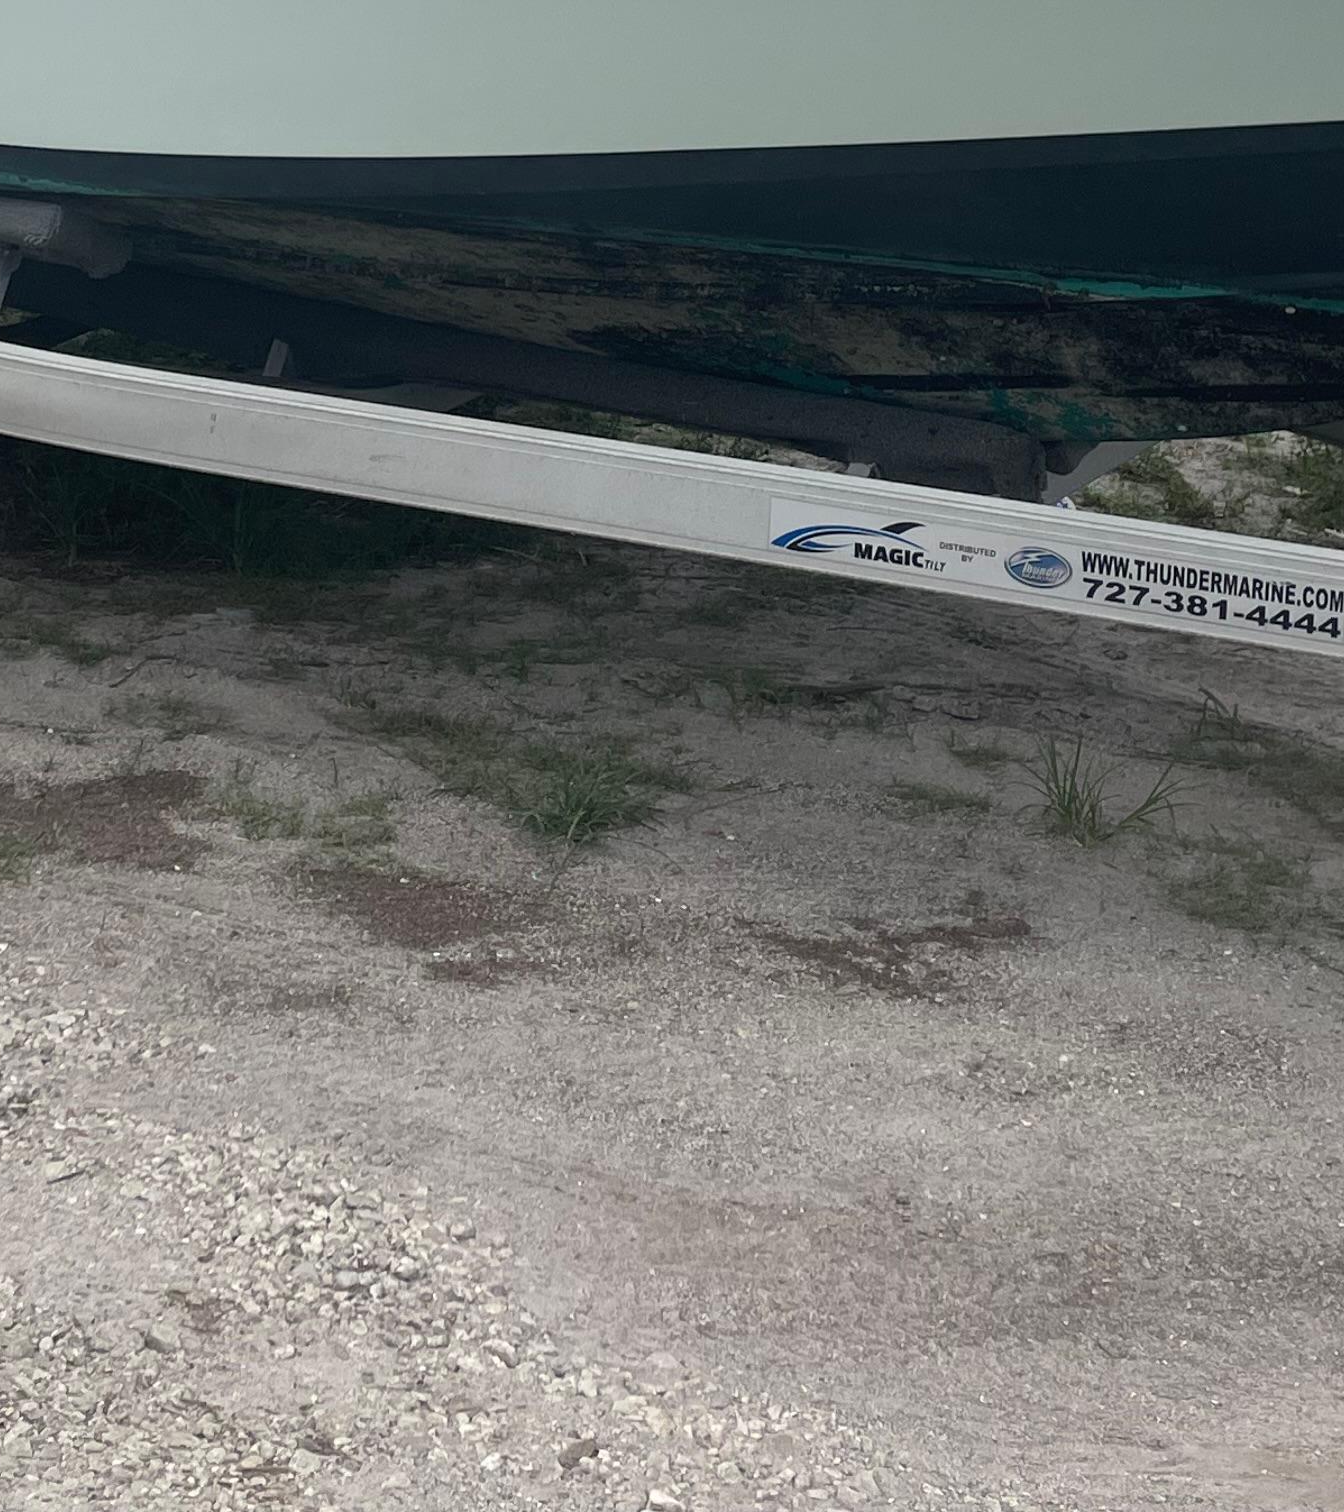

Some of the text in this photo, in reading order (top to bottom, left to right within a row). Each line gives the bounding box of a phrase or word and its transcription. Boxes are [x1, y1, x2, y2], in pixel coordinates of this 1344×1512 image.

[854, 542, 924, 569] MAGIC
[939, 541, 996, 558] DISTRIBUTED
[961, 553, 974, 563] BY
[1081, 550, 1344, 613] WWW.THUNDERMARINE.COM
[1081, 578, 1341, 638] 727-381-4444
